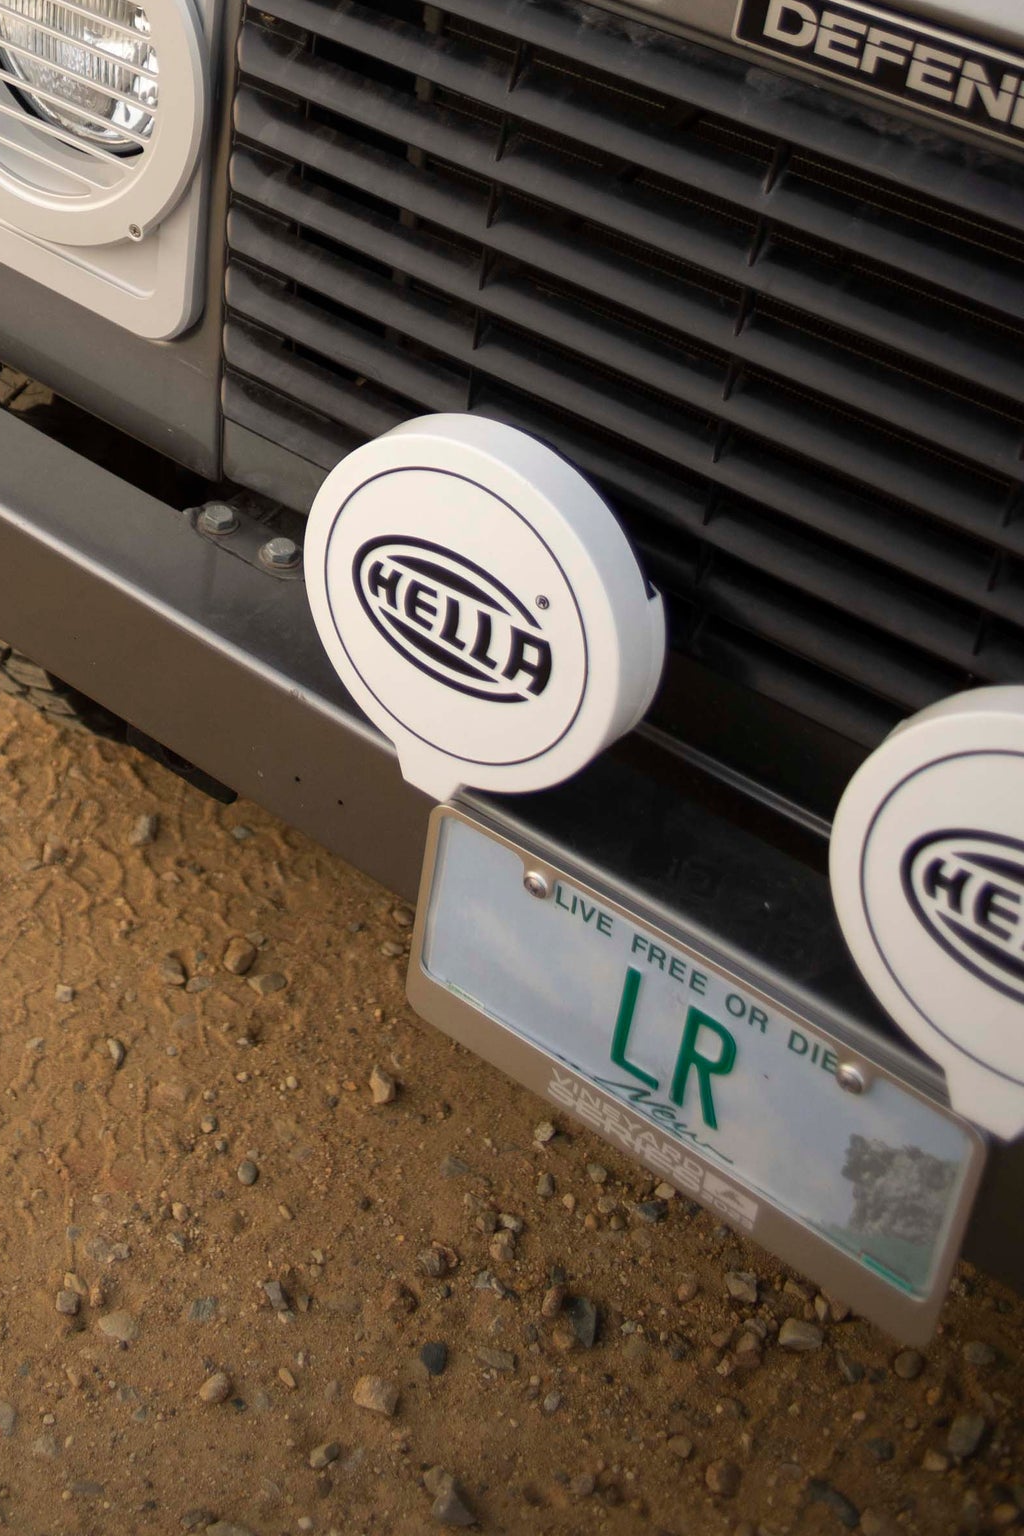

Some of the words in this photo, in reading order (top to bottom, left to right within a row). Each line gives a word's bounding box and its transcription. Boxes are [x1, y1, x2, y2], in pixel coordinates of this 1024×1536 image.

[368, 560, 552, 696] HELLA
[924, 857, 1024, 952] HE
[555, 885, 614, 937] LIVE
[631, 933, 708, 995] FREE
[725, 993, 769, 1033] OR
[788, 1029, 839, 1074] DIE
[610, 966, 736, 1130] LR
[547, 1080, 700, 1193] SERIES
[551, 1067, 703, 1178] VINEYARD
